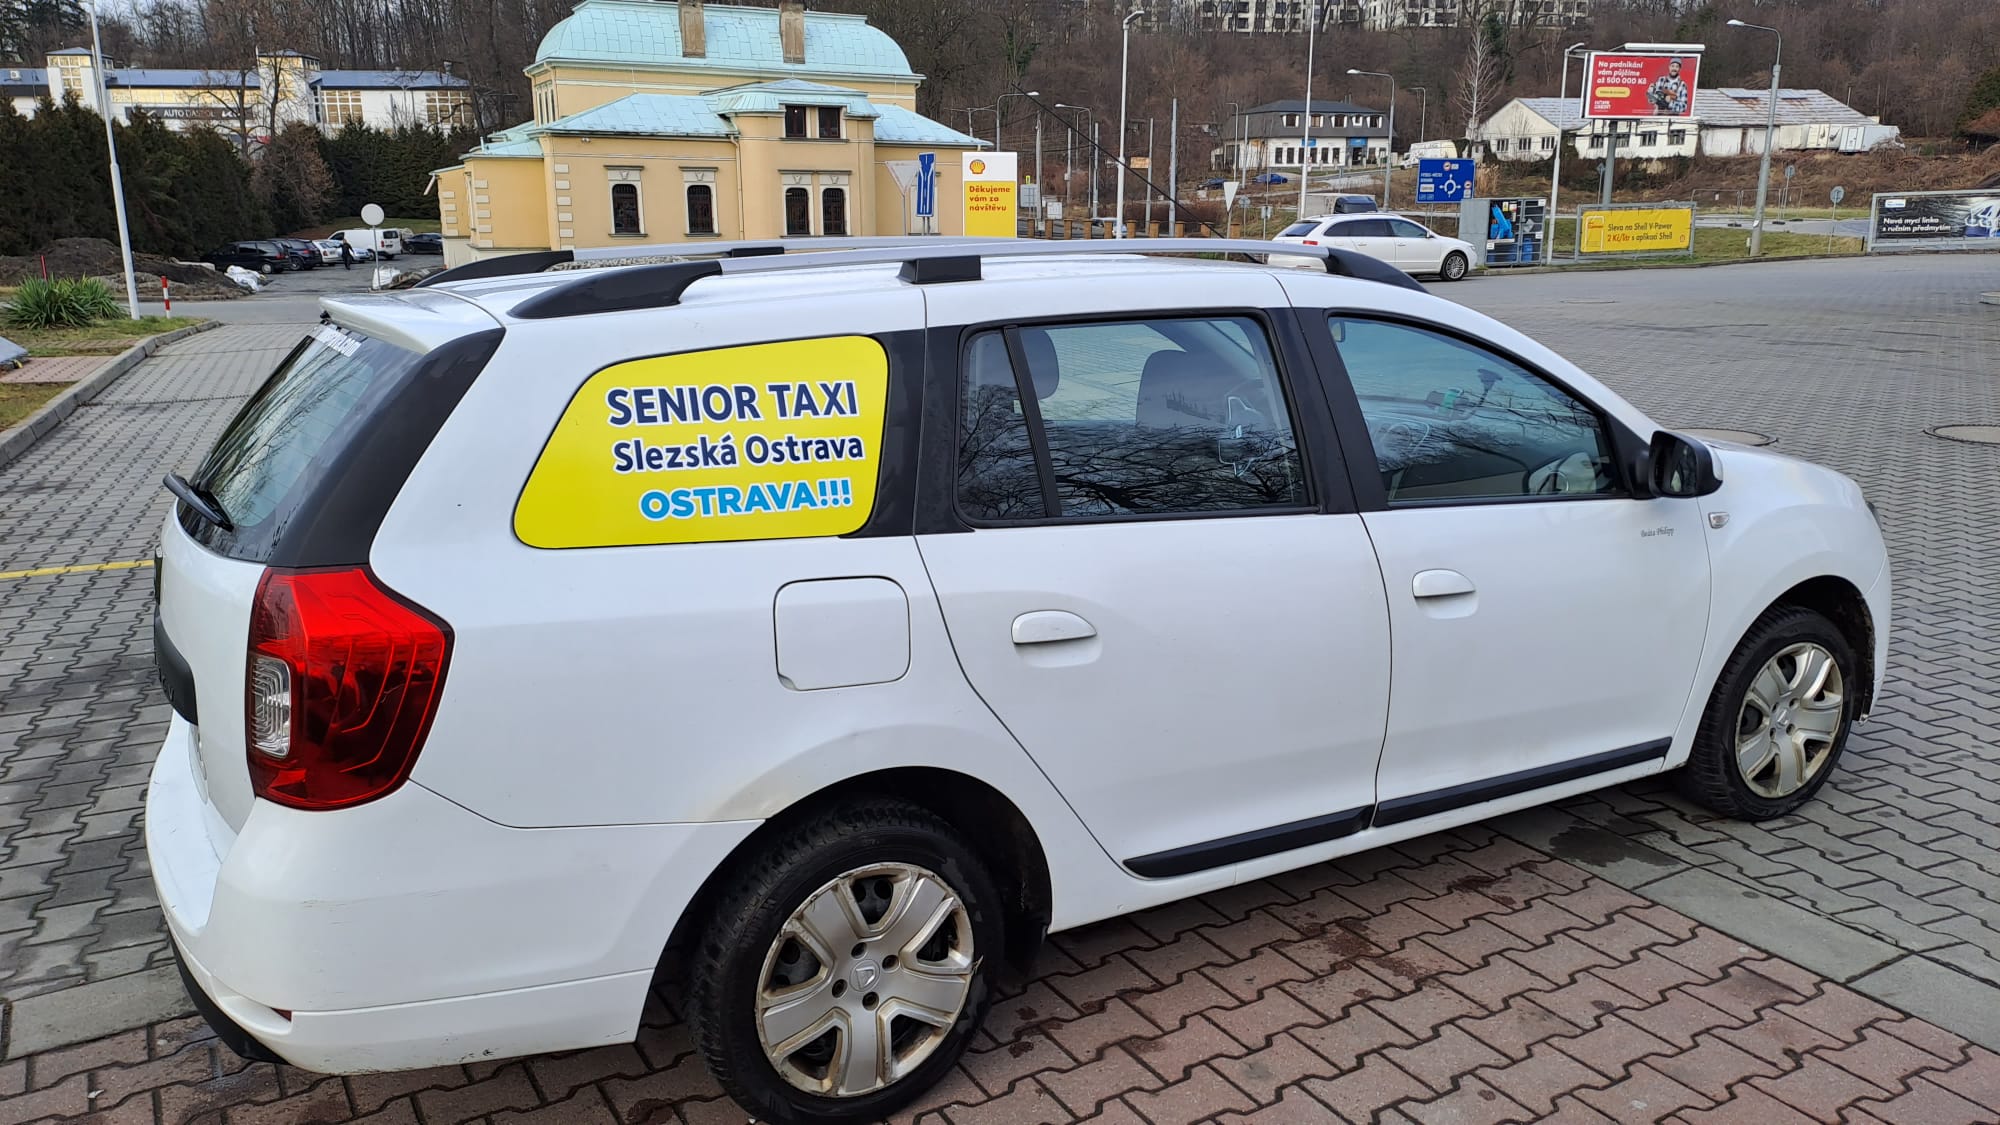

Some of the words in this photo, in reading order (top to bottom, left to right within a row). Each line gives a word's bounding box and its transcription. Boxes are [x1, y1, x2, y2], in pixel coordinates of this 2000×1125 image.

[1609, 61, 1644, 69] podnikání
[1598, 68, 1613, 76] vám
[1613, 68, 1640, 77] půjčíme
[1597, 76, 1605, 84] až
[163, 109, 185, 118] AUTO
[969, 186, 1010, 194] Děkujeme
[969, 203, 1007, 211] návštěvu
[1904, 217, 1921, 225] mycí
[1607, 223, 1624, 232] Sleva
[1634, 222, 1648, 231] Shell
[1887, 224, 1911, 232] ručním
[1912, 223, 1951, 233] předmytím
[1659, 232, 1673, 240] Shell
[607, 384, 760, 426] SENIOR
[768, 381, 858, 418] TAXI
[613, 433, 737, 472] Slezská
[746, 434, 864, 465] Ostrava
[641, 479, 852, 519] OSTRAVA!!!
